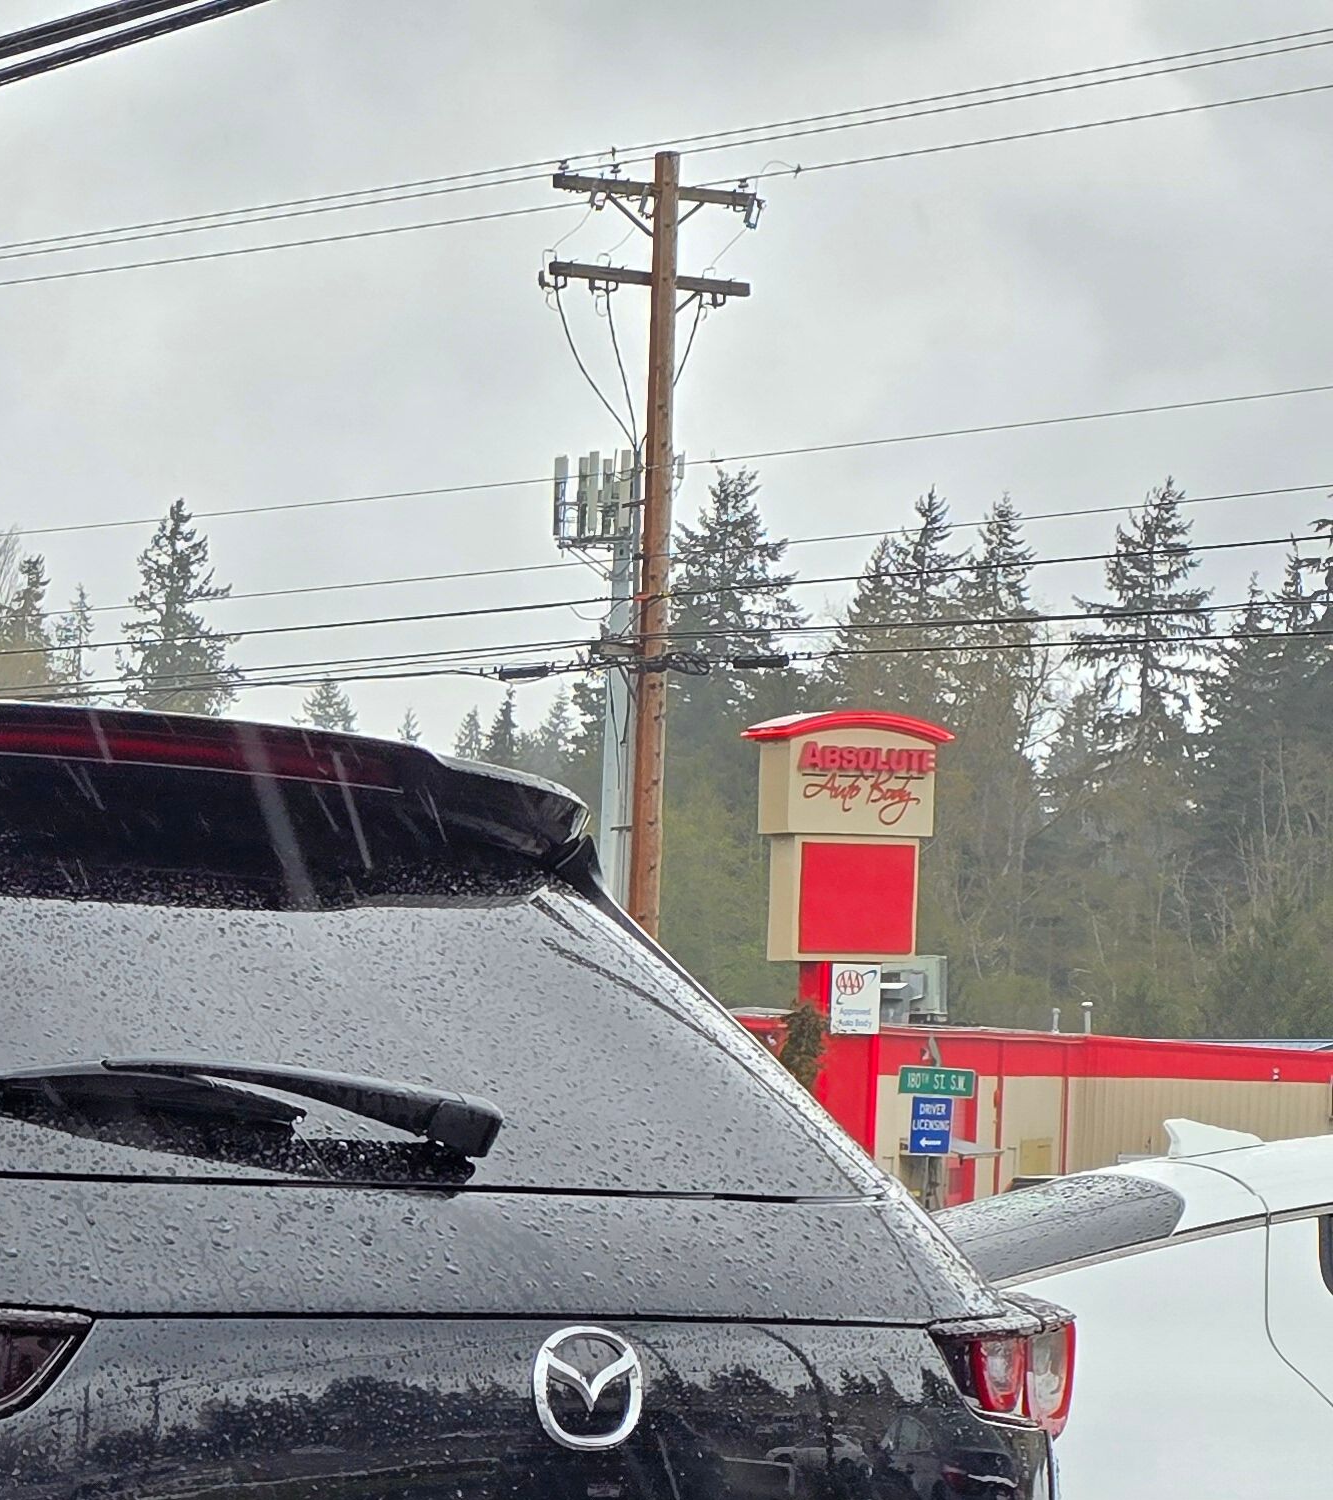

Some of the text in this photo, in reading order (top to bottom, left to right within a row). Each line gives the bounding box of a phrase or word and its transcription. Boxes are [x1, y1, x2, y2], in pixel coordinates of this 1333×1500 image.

[798, 741, 937, 774] ABSOLUTE
[803, 769, 920, 825] Auto Body
[836, 970, 864, 995] AAA
[918, 1103, 947, 1116] DRIVER
[912, 1119, 951, 1131] LICENSING
